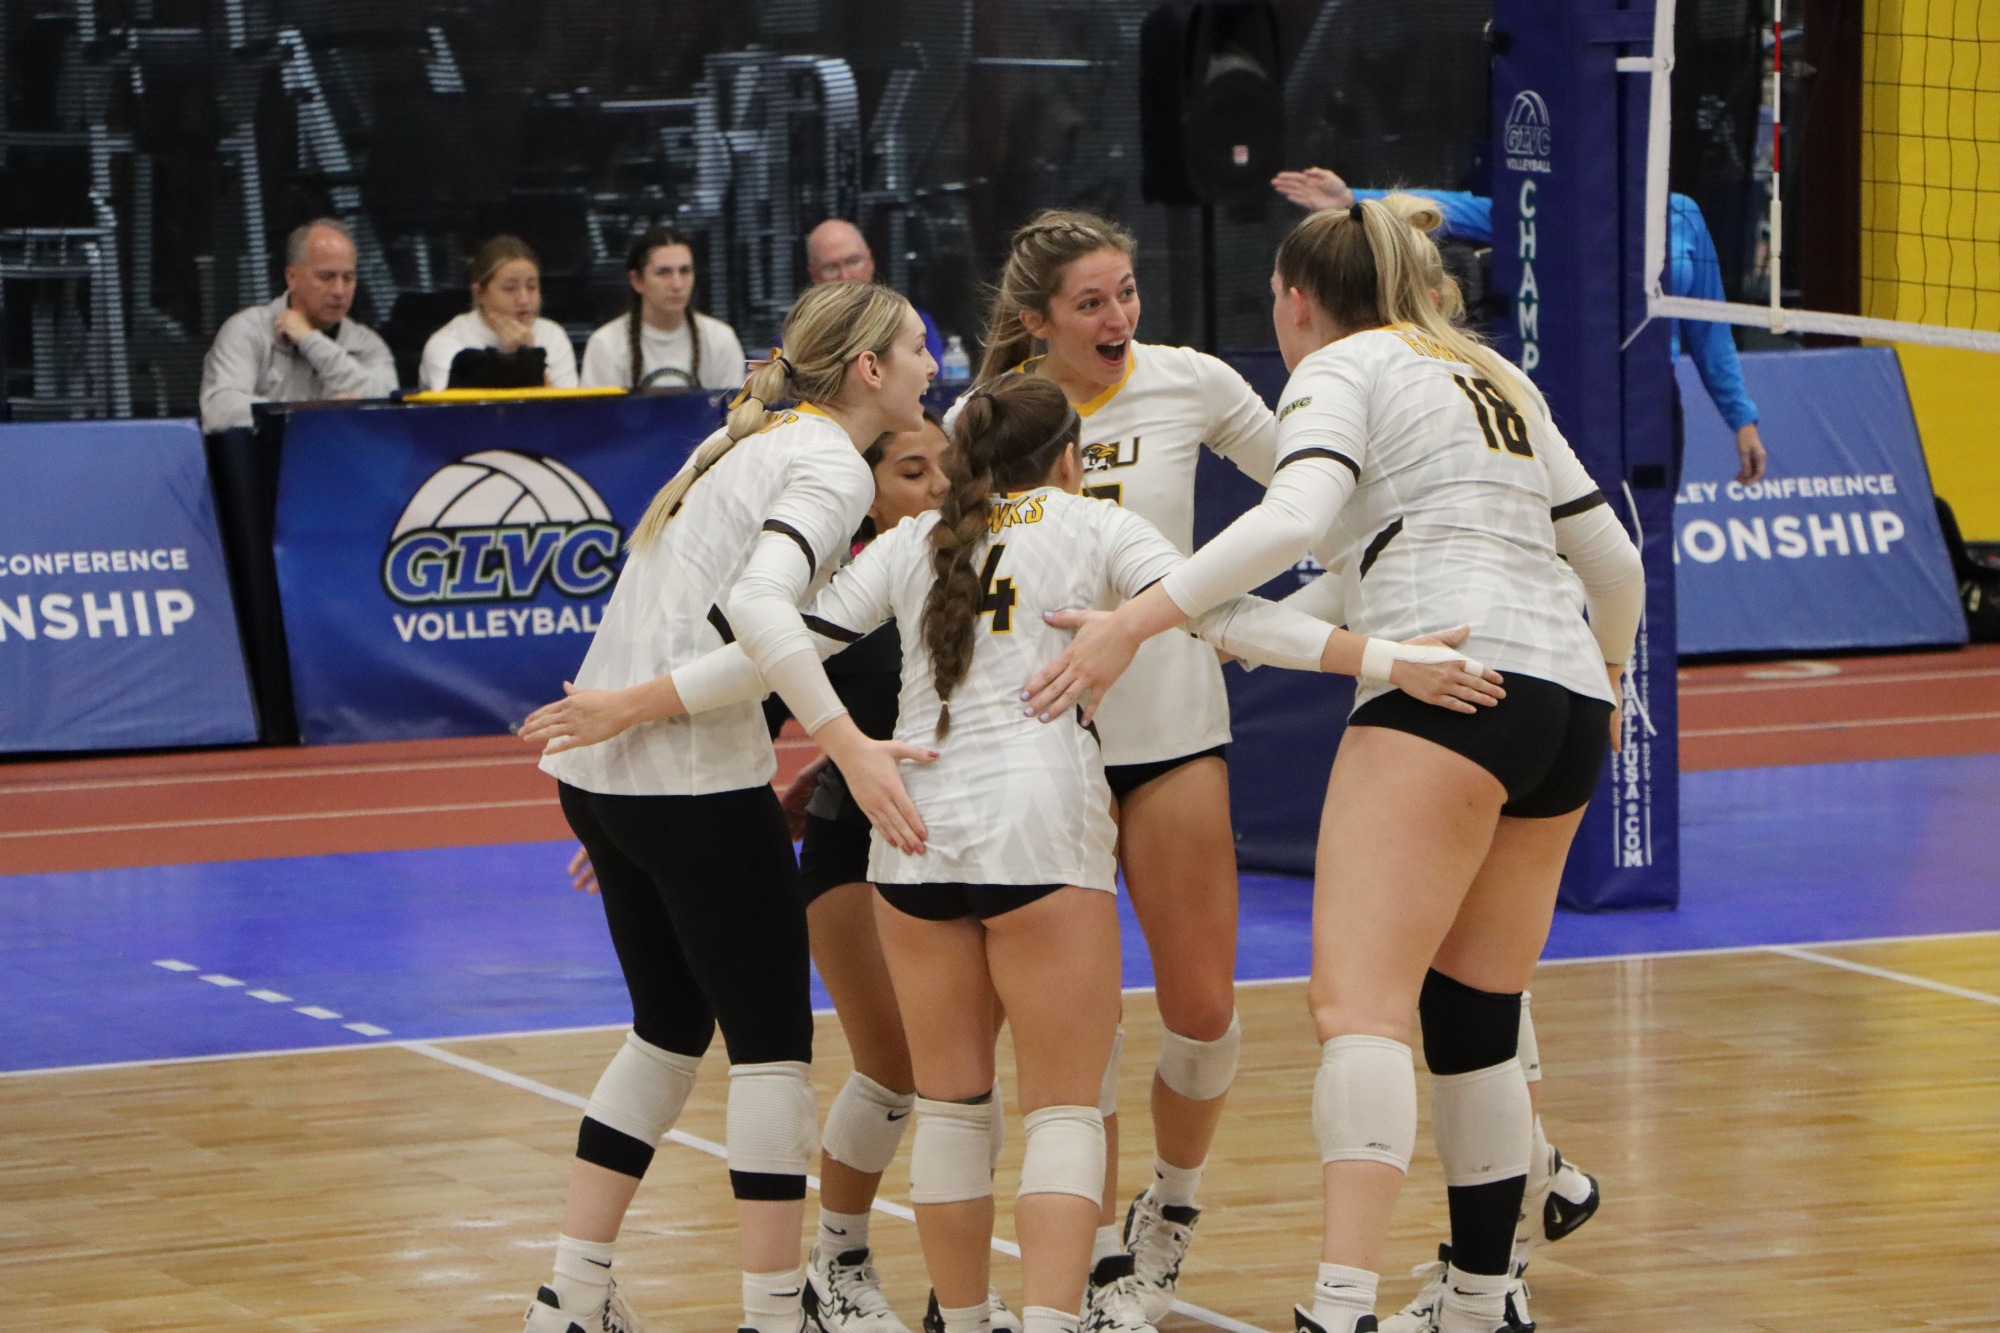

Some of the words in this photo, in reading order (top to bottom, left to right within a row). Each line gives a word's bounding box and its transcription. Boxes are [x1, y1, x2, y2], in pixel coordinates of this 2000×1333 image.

[1506, 158, 1551, 173] VOLLEYBALL
[1453, 374, 1535, 460] 18
[1726, 474, 1897, 501] CONFERENCE
[384, 522, 621, 604] GLVC
[977, 544, 1018, 635] 4
[393, 603, 608, 643] VOLLEYBAL
